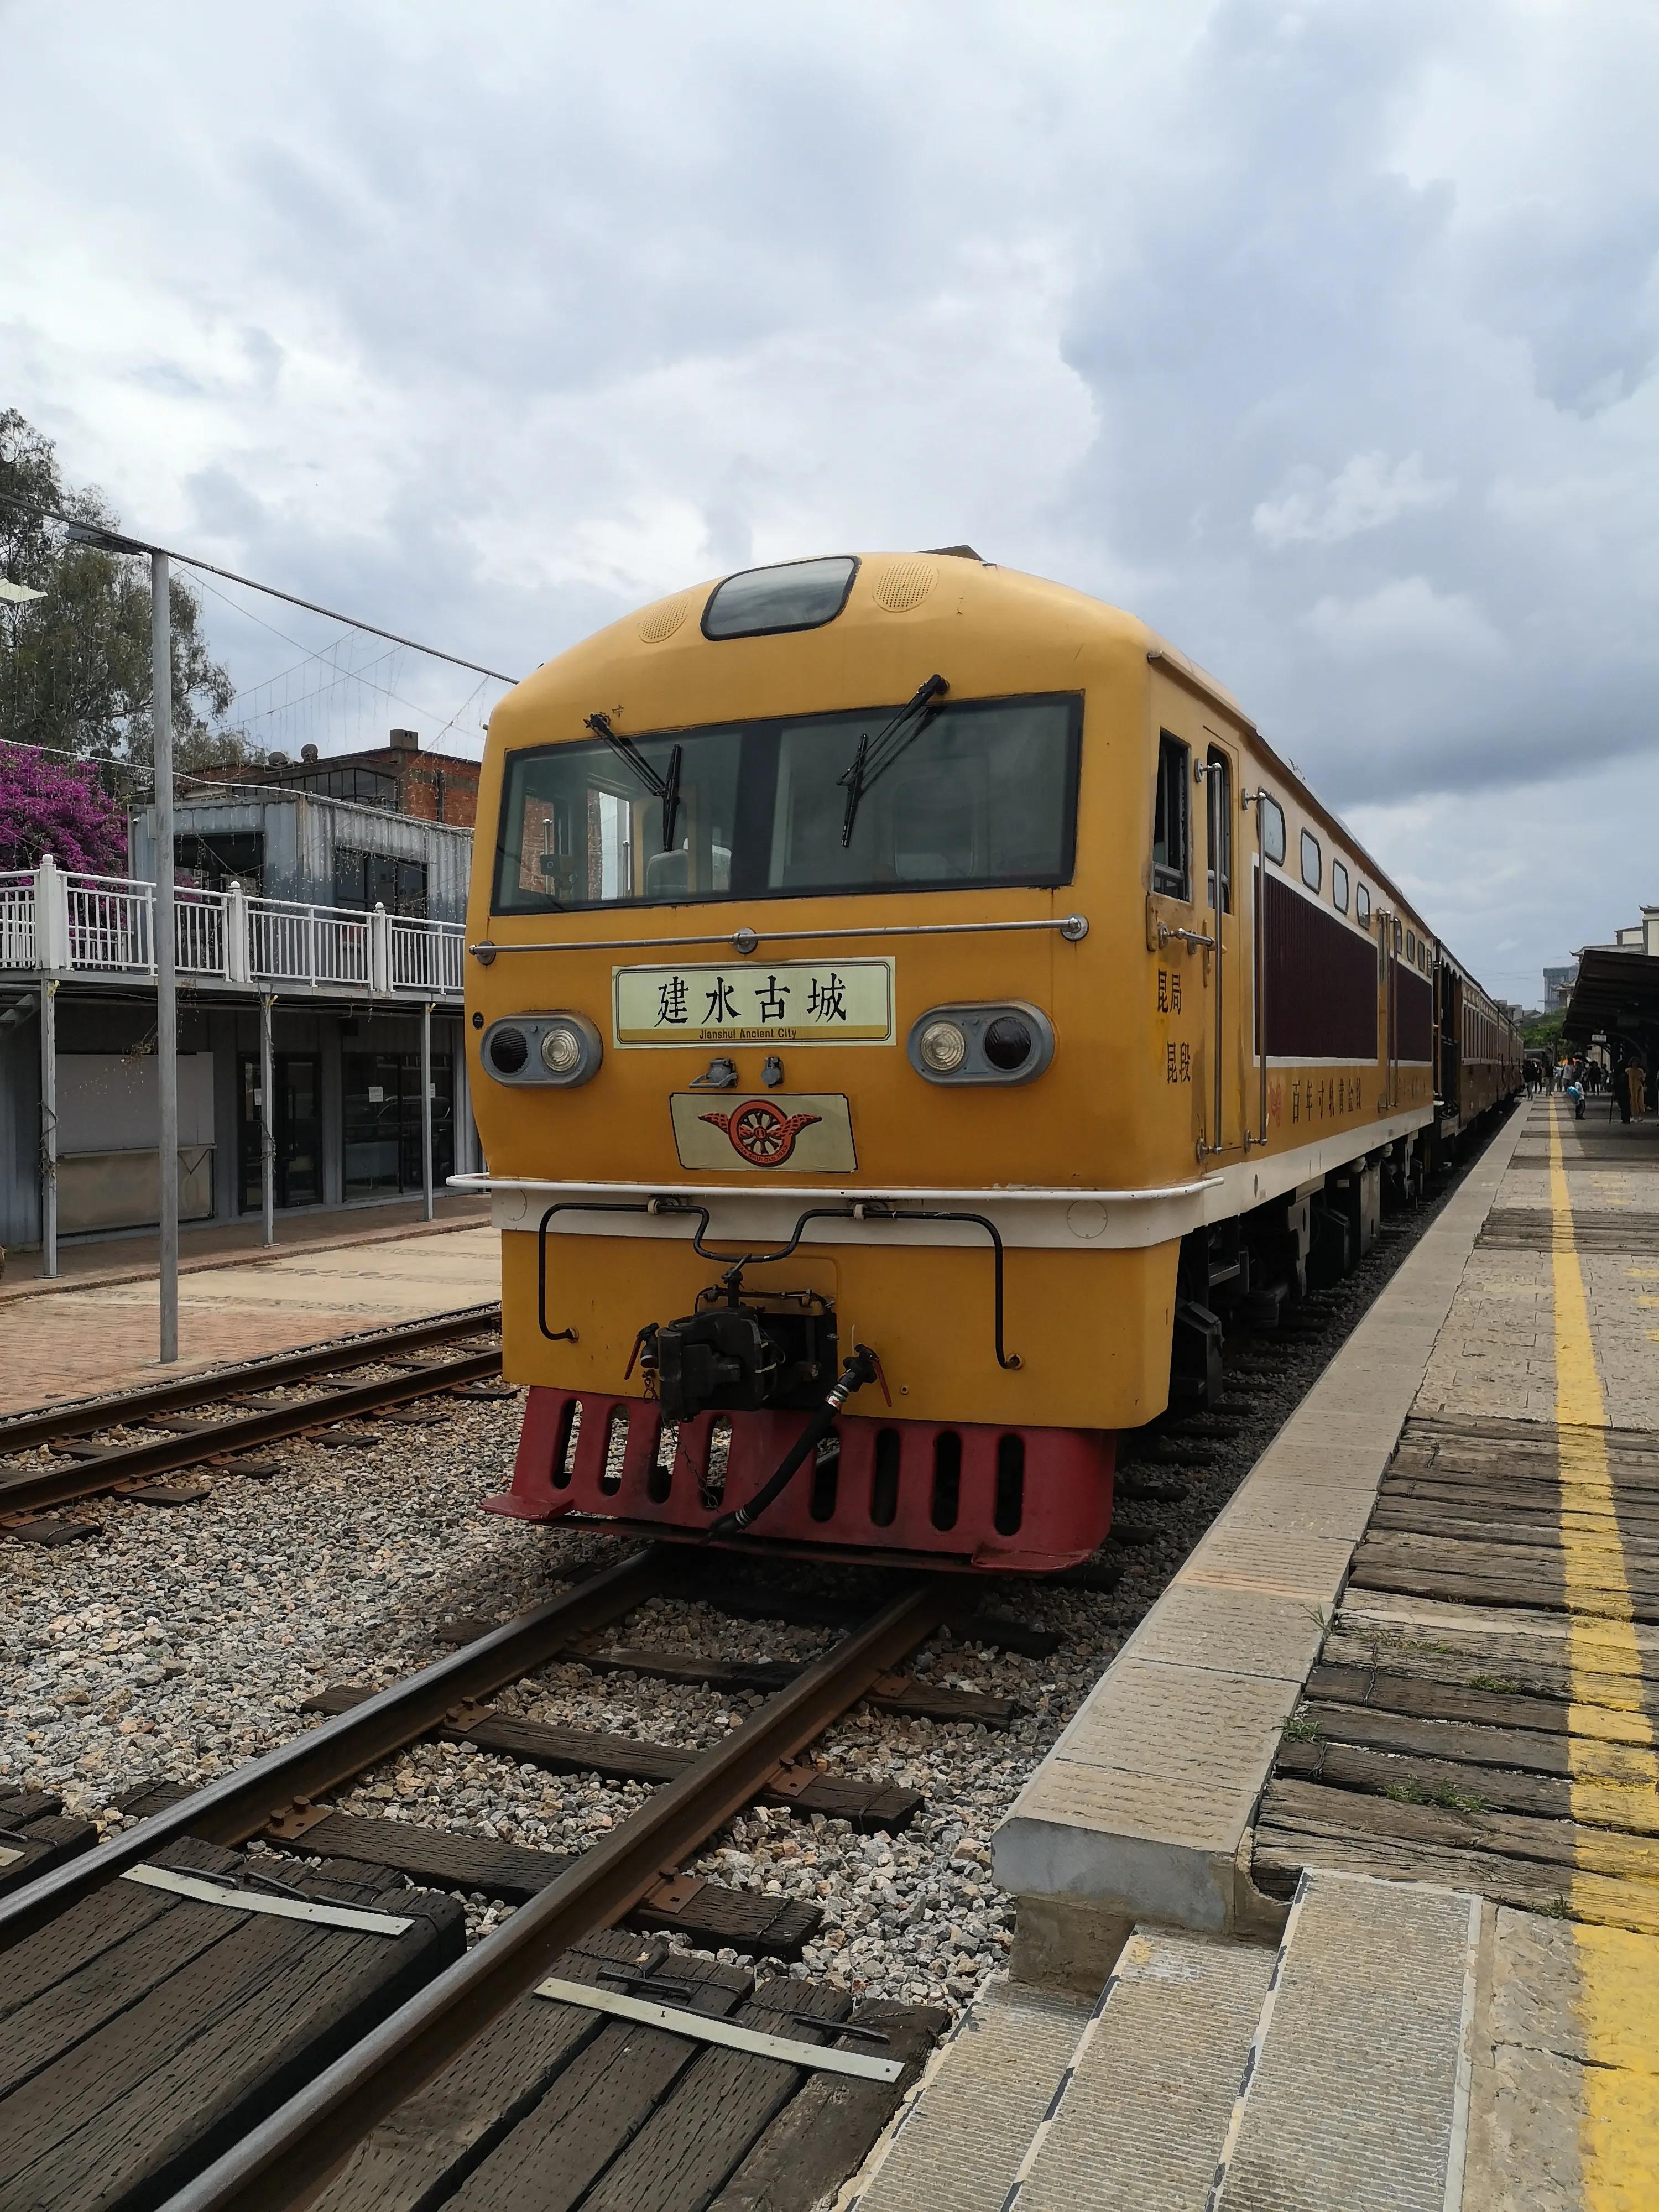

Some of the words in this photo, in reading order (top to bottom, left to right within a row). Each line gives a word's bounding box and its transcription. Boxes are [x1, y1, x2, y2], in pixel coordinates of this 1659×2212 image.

[654, 973, 847, 1027] 建水古城
[1157, 968, 1182, 1015] 昆局
[699, 1029, 735, 1039] Jianshui
[740, 1029, 774, 1039] Ancient
[778, 1027, 796, 1040] City
[1167, 1041, 1191, 1084] 昆段
[735, 1142, 747, 1155] JIAN
[776, 1144, 789, 1159] TRAIN
